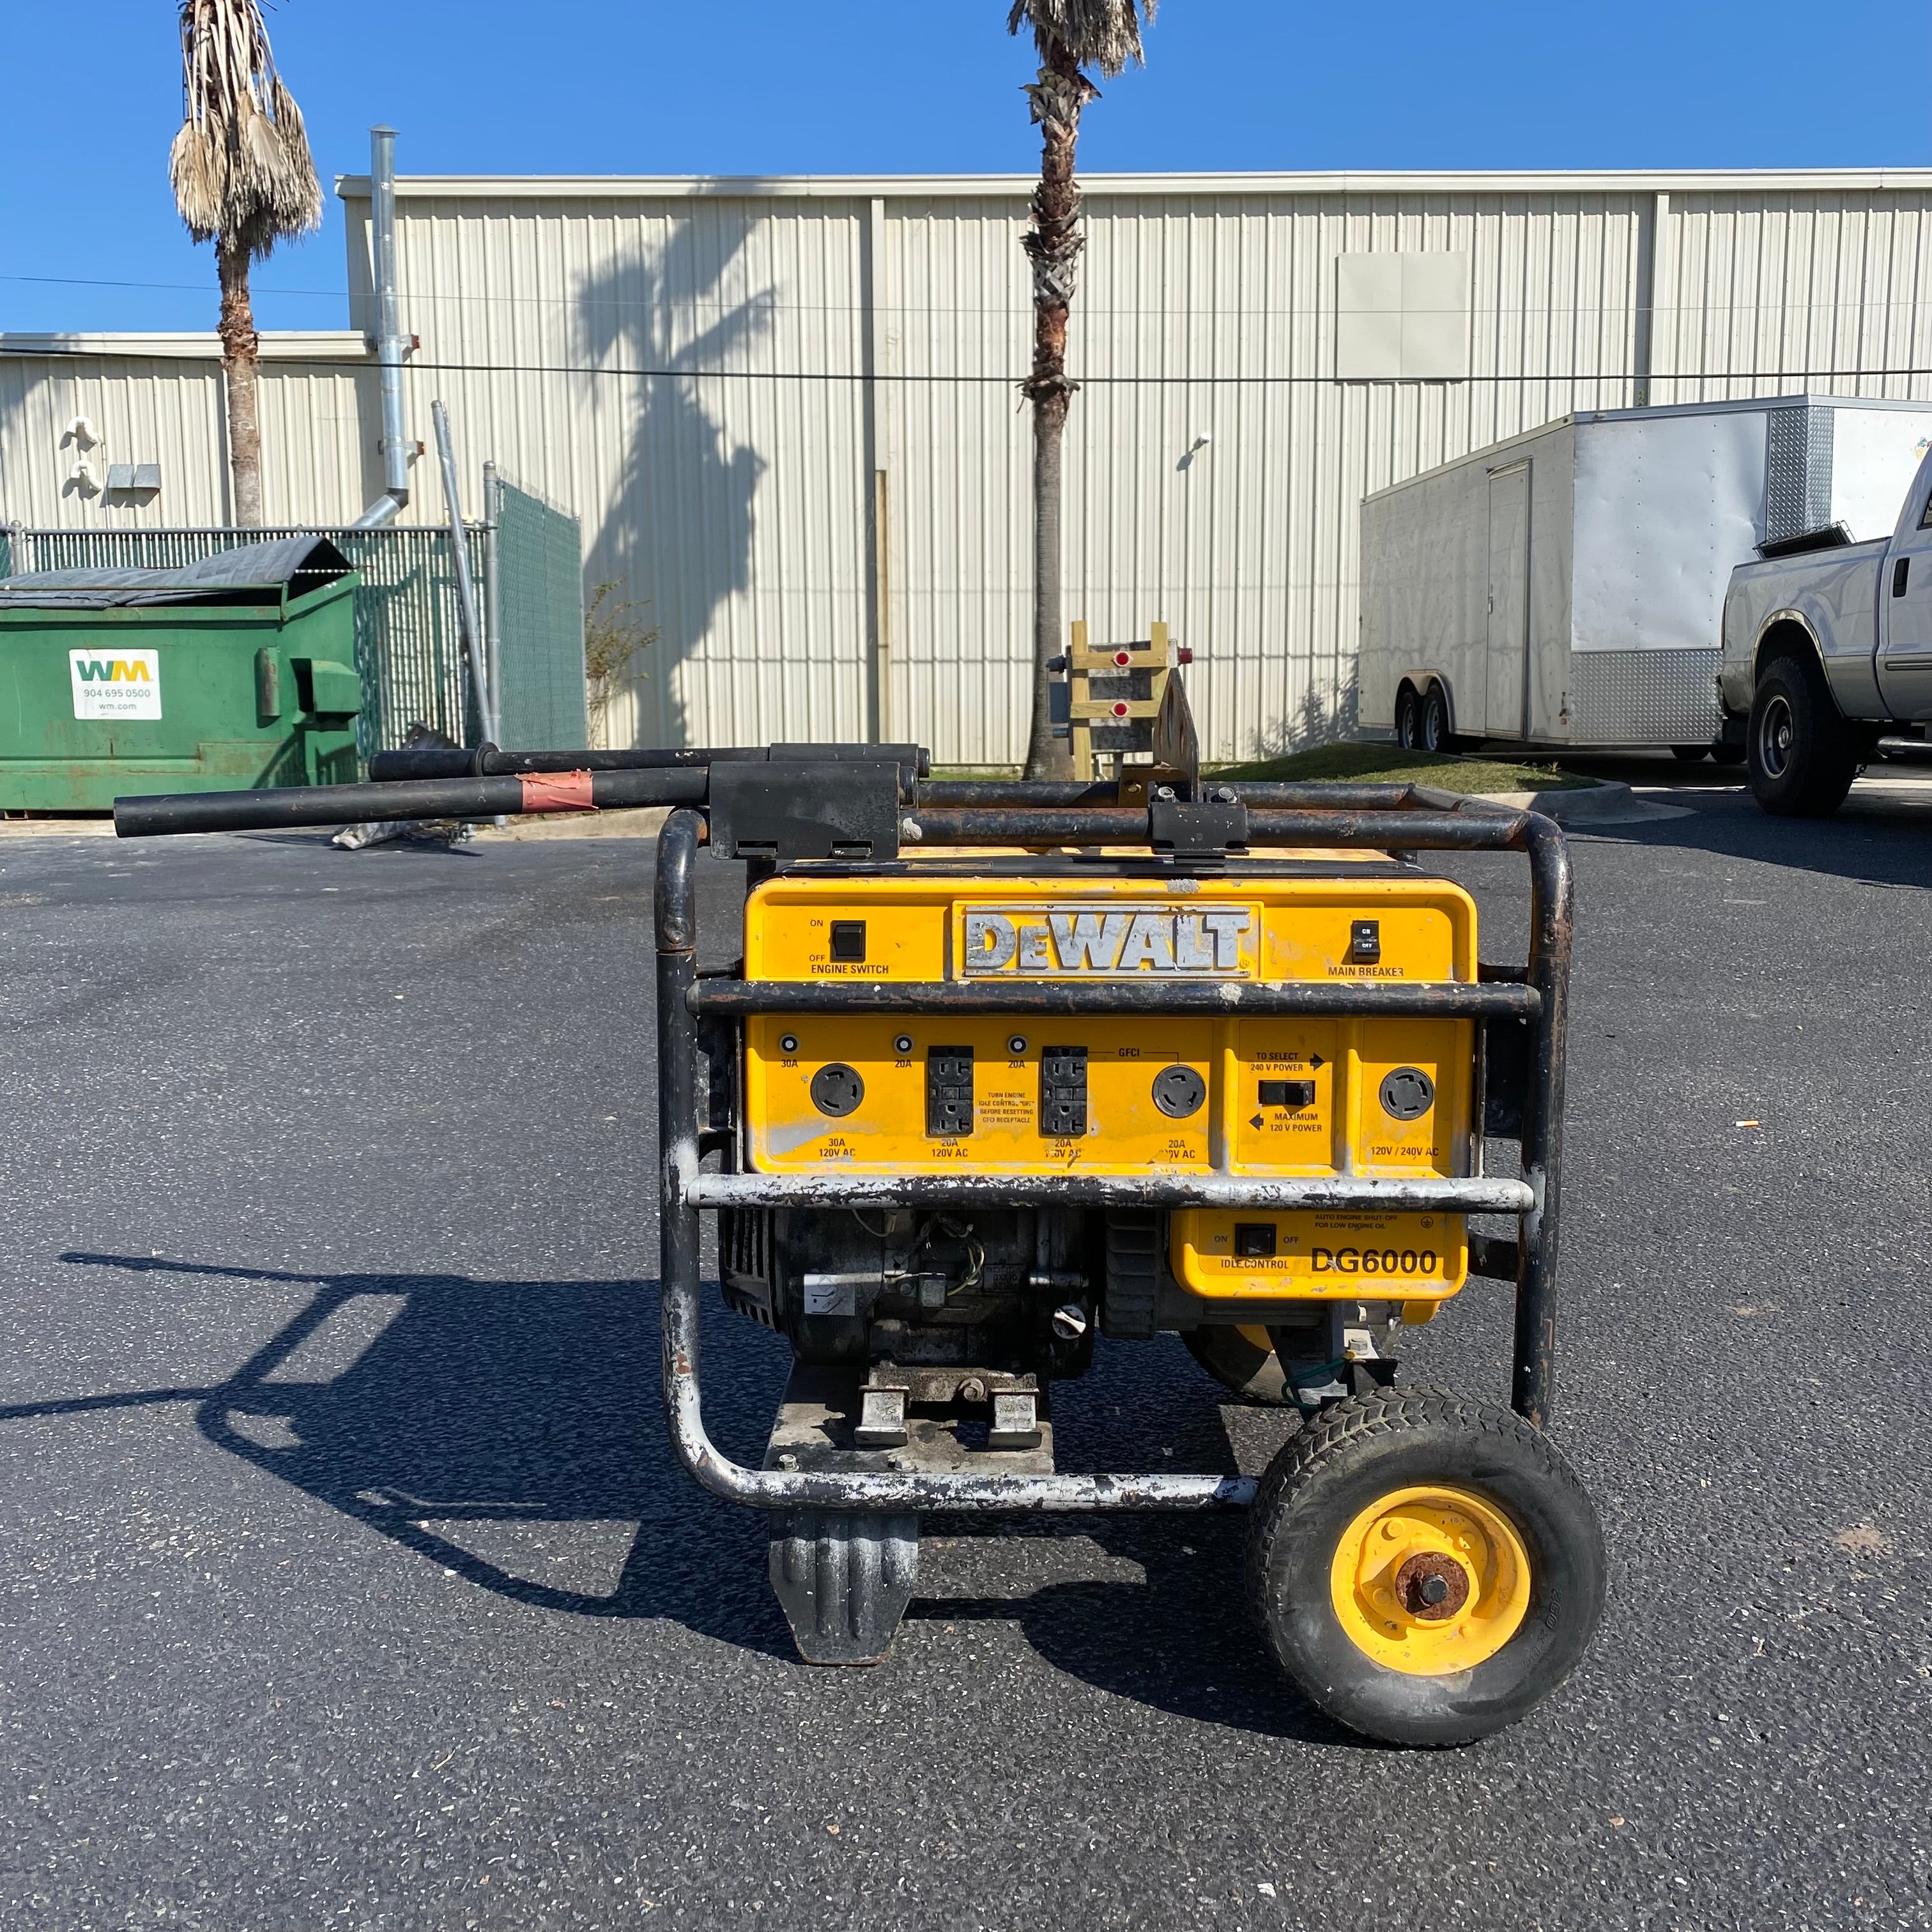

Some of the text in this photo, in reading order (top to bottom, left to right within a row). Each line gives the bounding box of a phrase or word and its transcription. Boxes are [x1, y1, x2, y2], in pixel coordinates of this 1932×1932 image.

[75, 660, 151, 682] WM
[84, 689, 151, 697] 904 695 0500
[809, 954, 825, 962] OFF
[811, 964, 889, 974] ENGINE SWITCH
[1328, 967, 1404, 977] MAIN BREAKER
[1118, 1048, 1140, 1057] GFCI
[1269, 1052, 1298, 1061] SELECT
[781, 1059, 799, 1068] 30A
[894, 1059, 912, 1068] 20A
[1008, 1059, 1026, 1069] 20A
[1250, 1063, 1303, 1071] 240 V POWER
[828, 1138, 846, 1147] 30A
[941, 1138, 959, 1147] 20A
[1054, 1138, 1072, 1148] 20A
[1168, 1139, 1186, 1149] 20A
[819, 1148, 856, 1157] 120V AC
[931, 1148, 969, 1158] 120V AC
[1068, 1149, 1082, 1158] AC
[1182, 1149, 1196, 1158] AC
[1370, 1146, 1393, 1156] 120V
[1400, 1147, 1423, 1156] 240V
[1425, 1147, 1439, 1156] AC
[1221, 1259, 1289, 1269] IDLE CONTROL
[1312, 1247, 1437, 1274] DG6000
